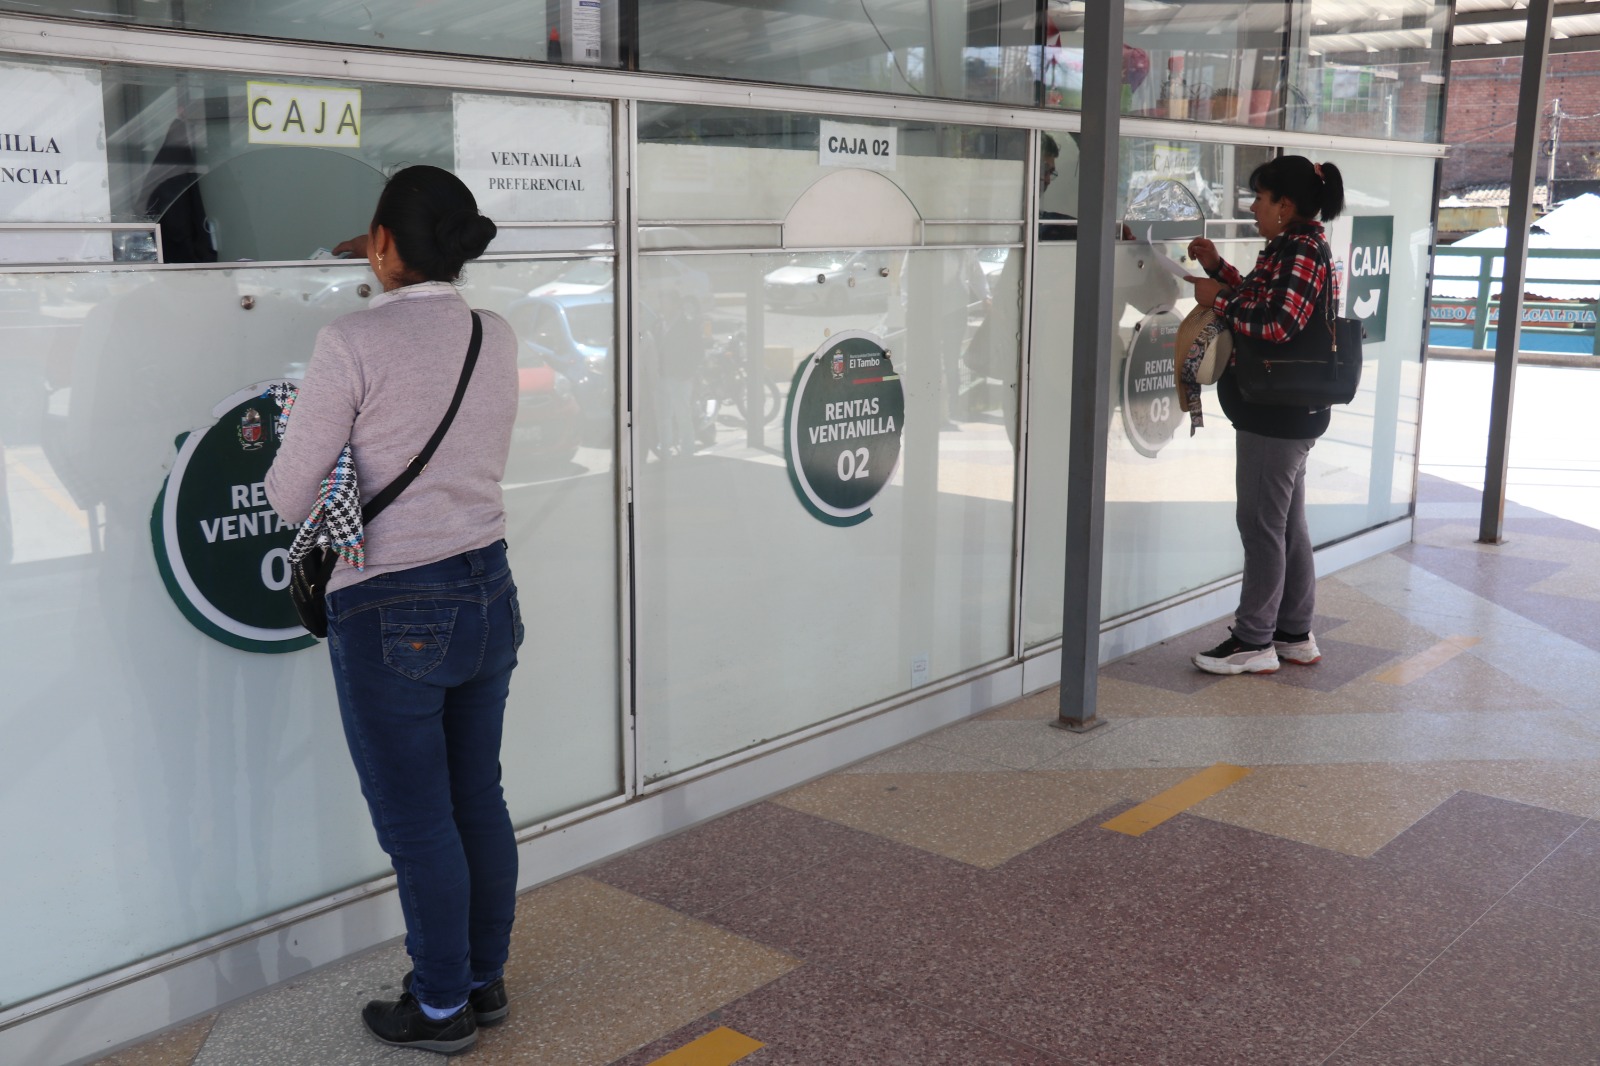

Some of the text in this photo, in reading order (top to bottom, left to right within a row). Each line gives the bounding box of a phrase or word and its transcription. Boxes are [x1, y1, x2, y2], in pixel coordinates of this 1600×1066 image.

[251, 97, 359, 136] CAJA
[0, 133, 61, 153] ILLA
[828, 136, 889, 156] CAJA 02
[491, 151, 582, 168] VENTANILLA
[488, 177, 585, 192] PREFERENCIAL
[1351, 245, 1390, 277] CAJA
[1520, 309, 1597, 322] LCALDIA
[849, 357, 880, 369] El Tambo
[1134, 374, 1176, 393] VENTANIL
[825, 397, 880, 421] RENTAS
[1150, 396, 1170, 423] 03
[808, 415, 896, 445] VENTANILLA
[837, 447, 870, 481] 02
[261, 547, 293, 591] 0
